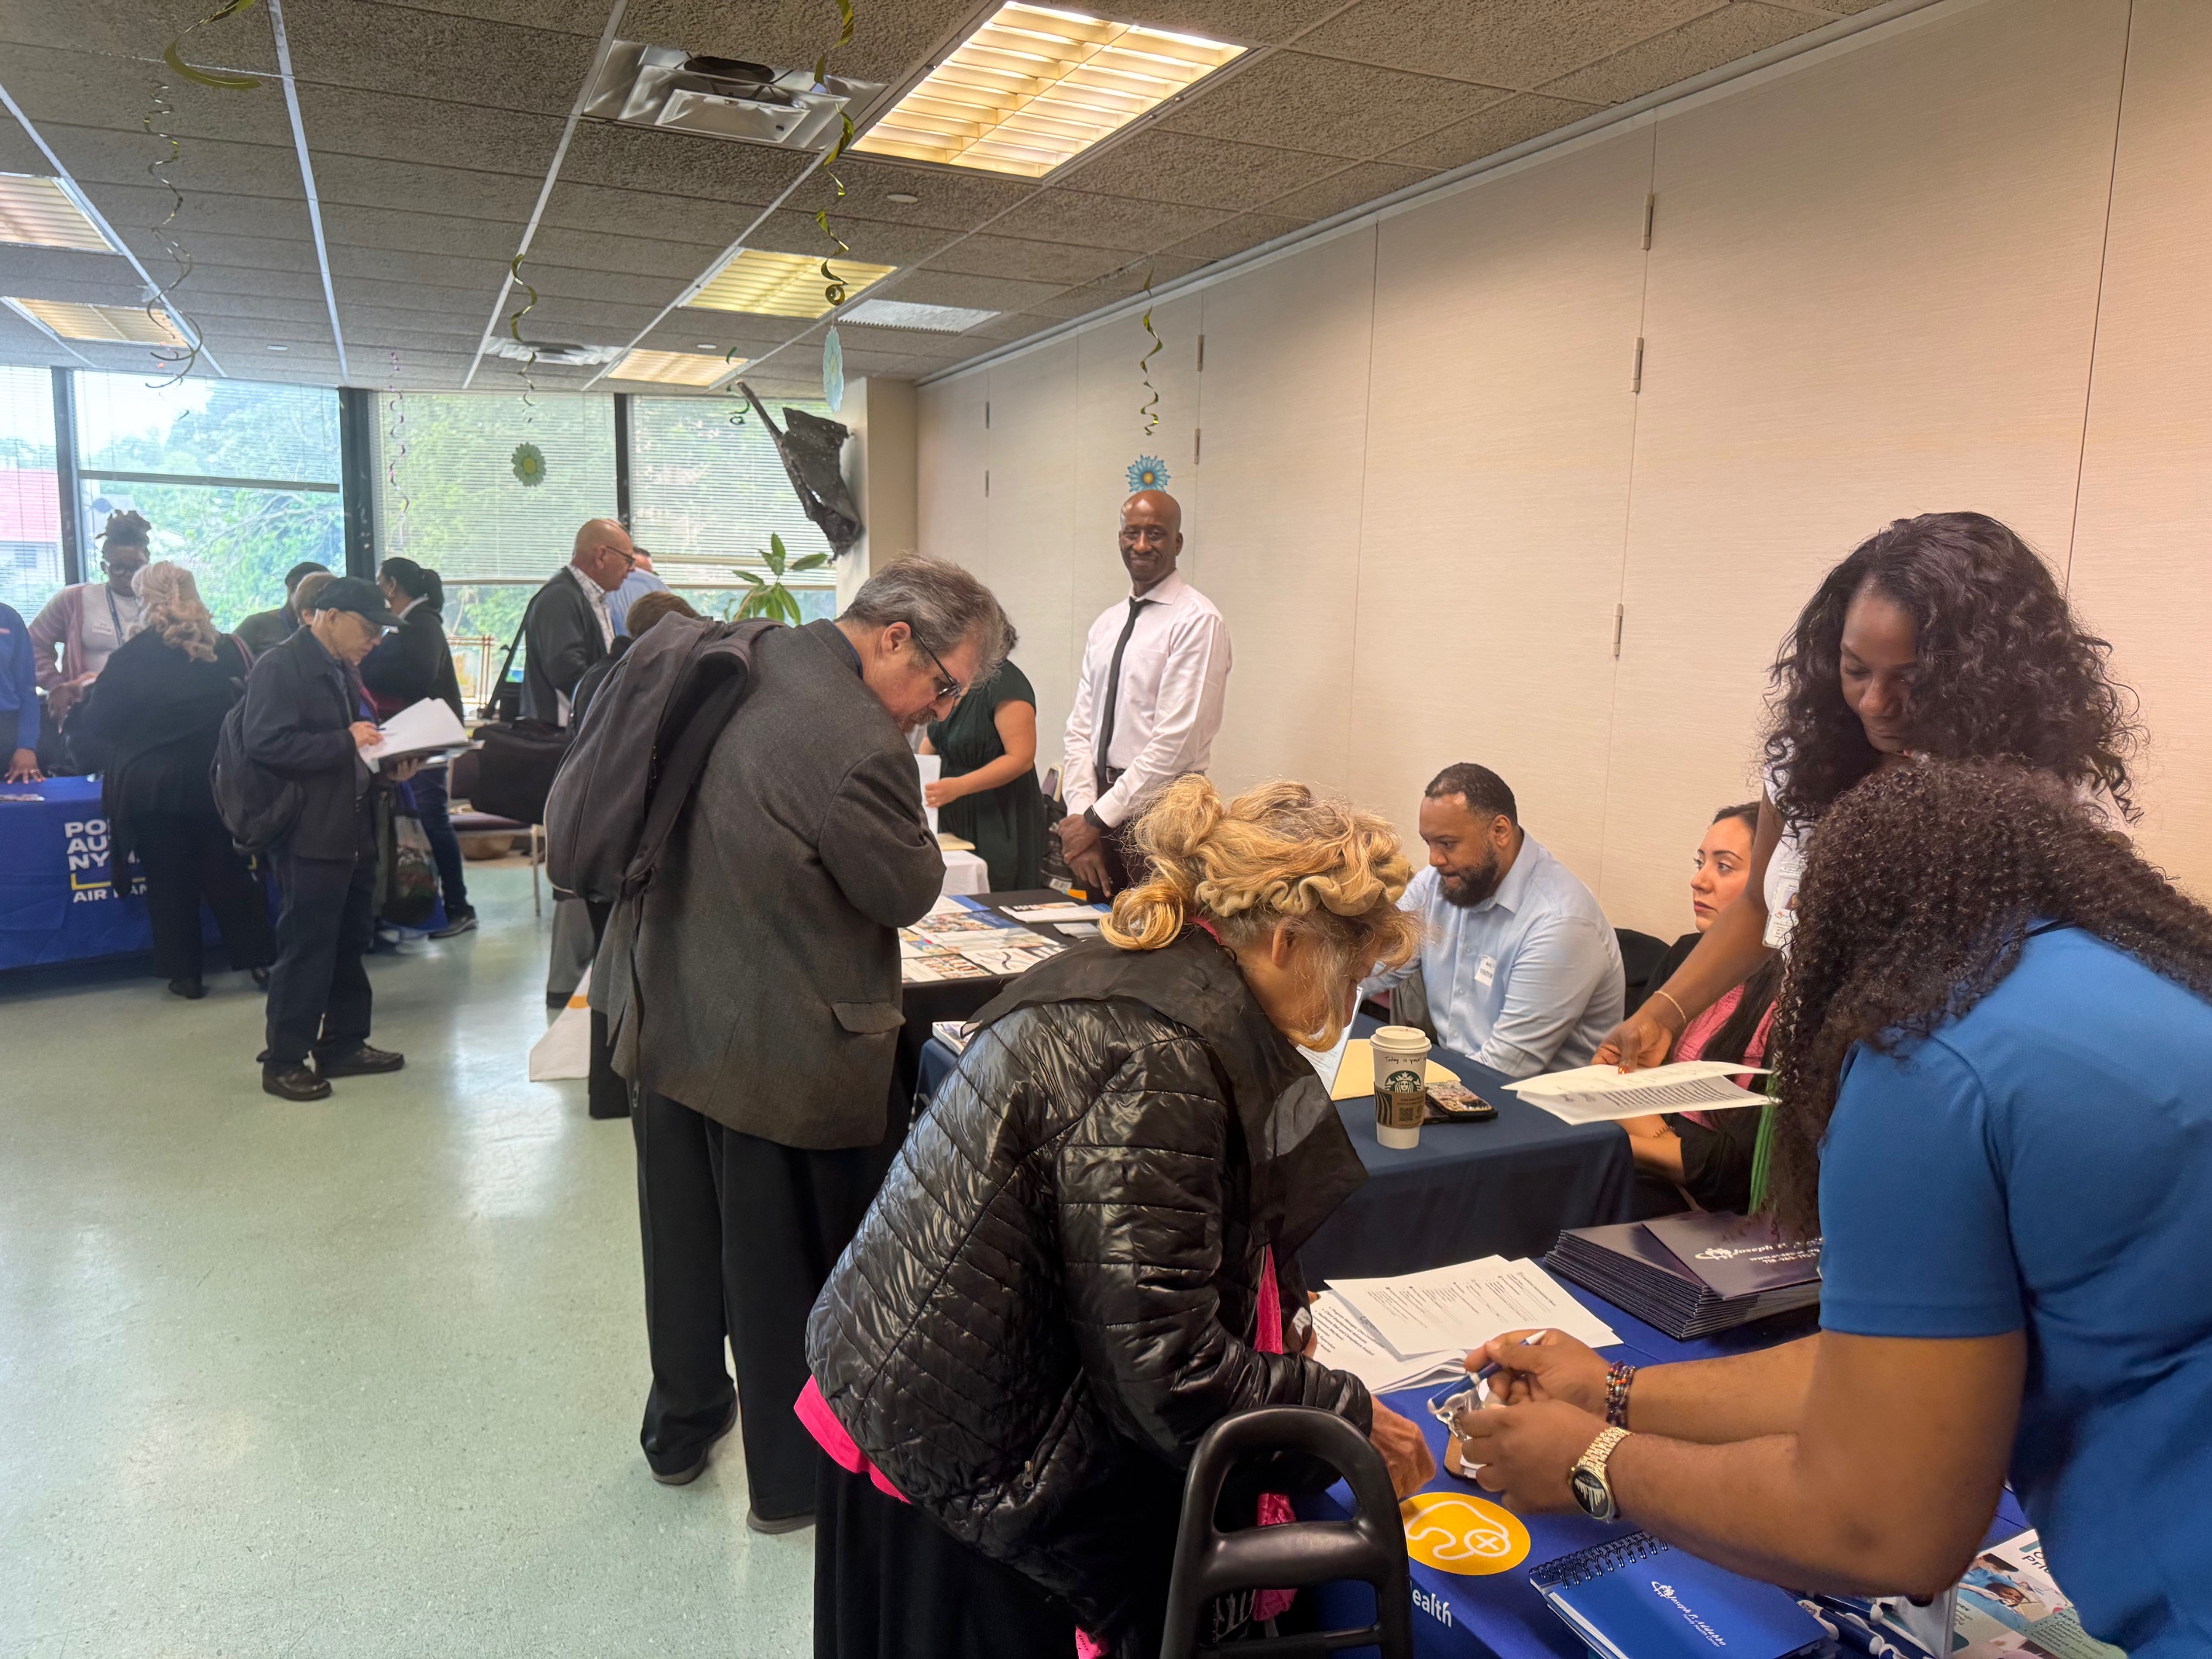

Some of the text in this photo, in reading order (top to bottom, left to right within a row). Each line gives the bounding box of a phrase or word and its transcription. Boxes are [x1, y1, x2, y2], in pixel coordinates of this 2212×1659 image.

[64, 819, 110, 838] PO
[67, 834, 111, 855] AU
[68, 851, 110, 871] NY
[73, 888, 108, 903] AIR
[1733, 1245, 1774, 1255] Joseph
[1410, 1580, 1451, 1627] ealth
[1670, 1596, 1691, 1613] Joseph
[1695, 1620, 1726, 1646] Addabbo
[1693, 1624, 1707, 1636] Health
[1706, 1635, 1720, 1647] Center
